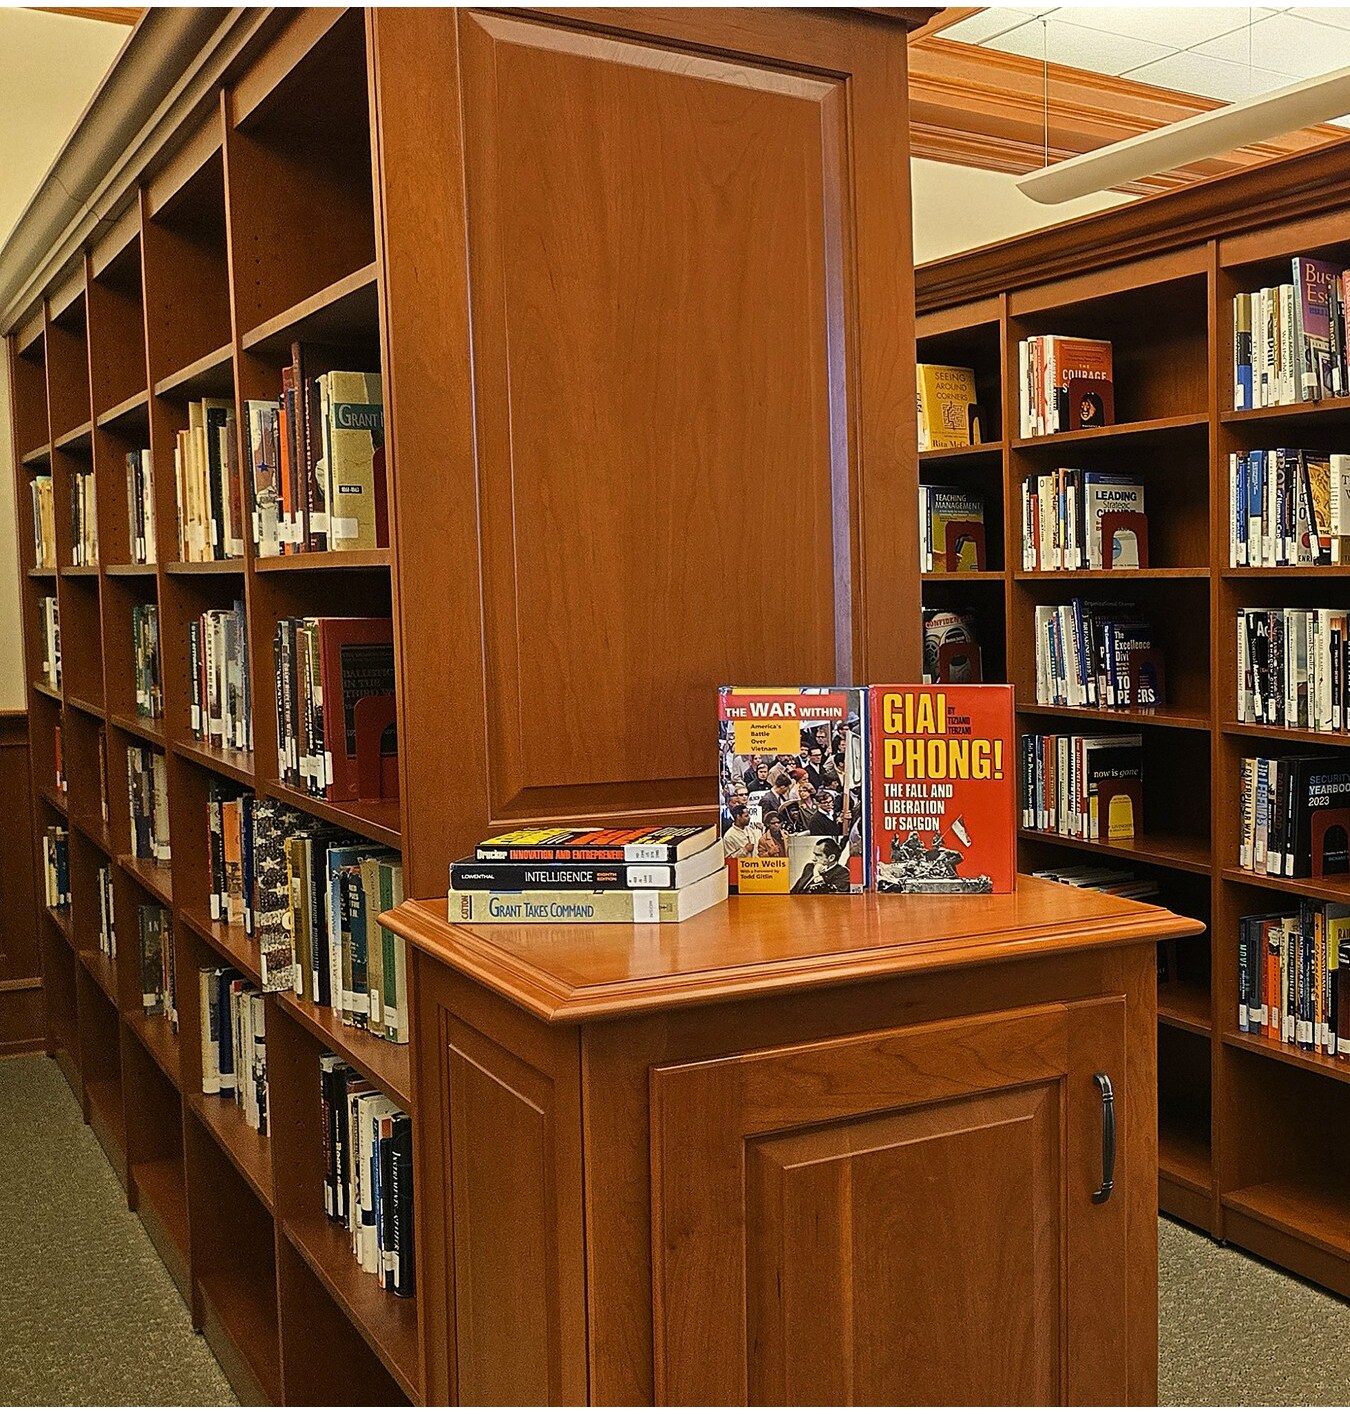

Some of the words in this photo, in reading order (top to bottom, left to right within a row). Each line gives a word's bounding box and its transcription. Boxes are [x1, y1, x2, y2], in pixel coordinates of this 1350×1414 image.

[935, 372, 966, 382] SEEING
[936, 382, 968, 392] AROUND
[936, 392, 969, 401] CORNERS
[338, 404, 378, 427] GRANT
[935, 494, 967, 502] TEACHING
[1095, 490, 1137, 501] LEADING
[935, 502, 981, 510] MANAGEMENT
[1102, 501, 1131, 510] Strategic
[1114, 631, 1125, 639] The
[1114, 640, 1151, 651] Excellence
[1115, 651, 1130, 662] Divi
[725, 707, 747, 717] THE
[749, 702, 797, 717] WAR
[799, 707, 843, 717] WITHIN
[883, 693, 946, 734] GIAI
[947, 706, 956, 715] BY
[947, 716, 971, 725] TIZIANO
[947, 726, 972, 735] TERZANI
[883, 738, 1004, 780] PHONG!
[1093, 770, 1111, 778] now
[1111, 769, 1119, 777] is
[1119, 768, 1139, 778] gone
[884, 783, 903, 798] THE
[905, 783, 928, 798] FALL
[930, 784, 953, 798] AND
[1243, 768, 1253, 822] CATERPILLAR
[884, 799, 945, 815] LIBERATION
[1308, 796, 1330, 807] 2023
[884, 816, 898, 831] OF
[898, 816, 940, 831] SAIGON
[1243, 823, 1252, 840] WAY
[476, 849, 508, 860] Drucker
[509, 850, 554, 860] INNOVATION
[555, 850, 570, 860] AND
[524, 871, 594, 883] INTELLIGENCE
[461, 895, 469, 919] CATTON
[489, 897, 522, 917] GRANT
[523, 902, 549, 915] TAKES
[550, 902, 594, 917] COMMAND
